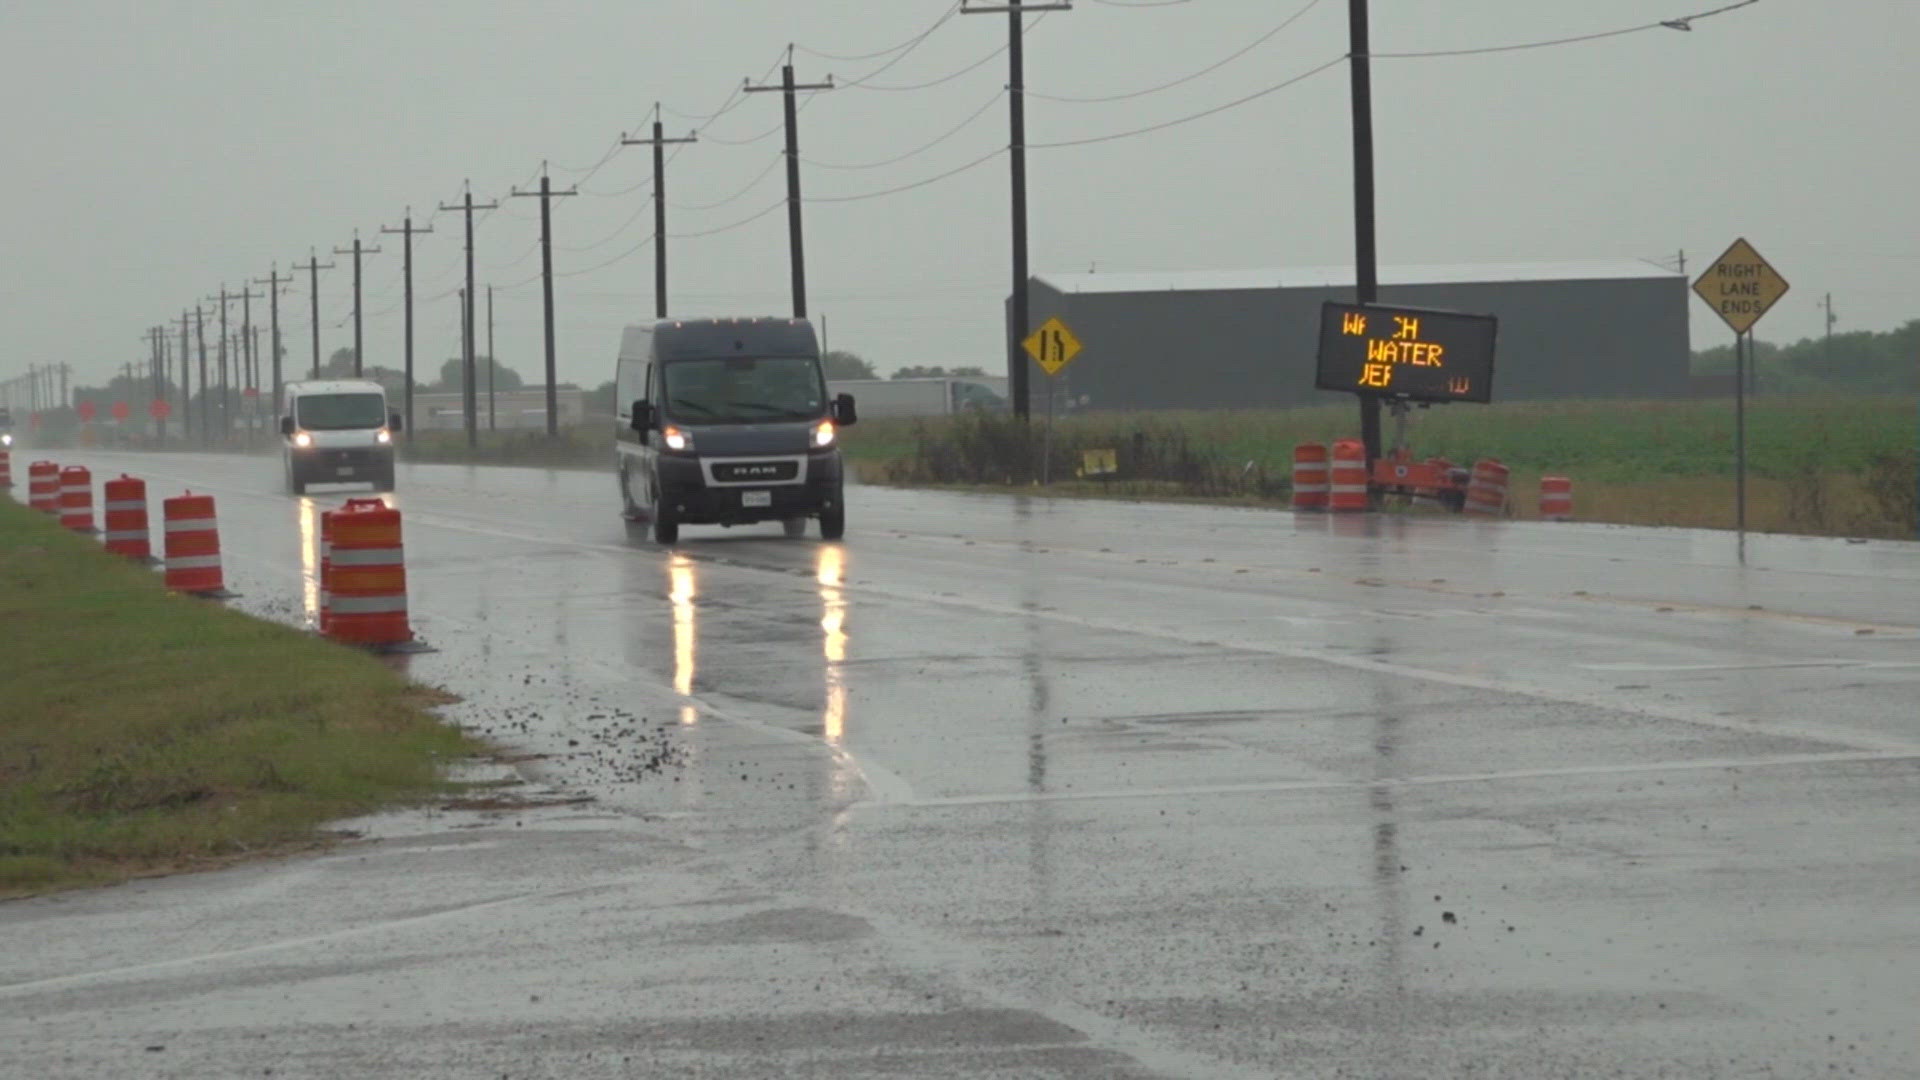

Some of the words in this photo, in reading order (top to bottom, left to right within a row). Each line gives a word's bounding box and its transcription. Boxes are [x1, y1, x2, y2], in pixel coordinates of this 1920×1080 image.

[1718, 263, 1763, 277] RIGHT
[1720, 282, 1760, 296] LANE
[1721, 300, 1761, 314] ENDS
[1367, 339, 1443, 367] WATER
[733, 466, 777, 475] RAM
